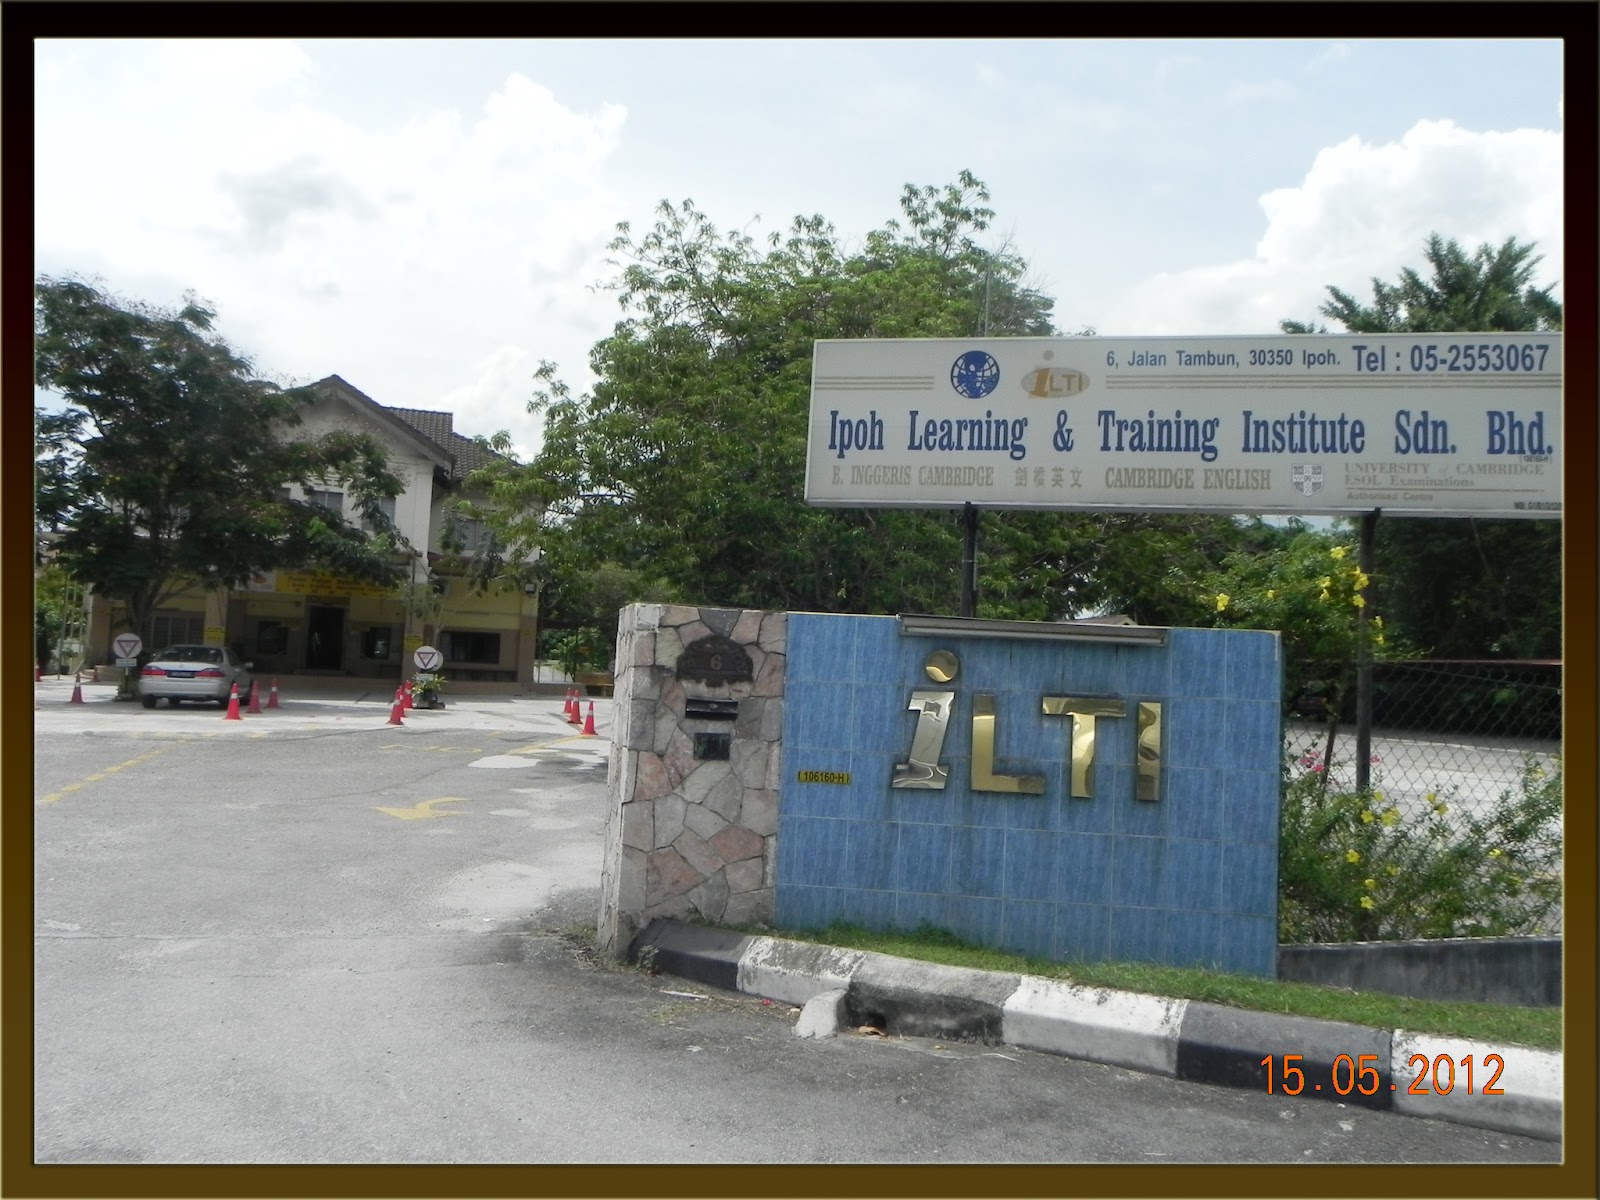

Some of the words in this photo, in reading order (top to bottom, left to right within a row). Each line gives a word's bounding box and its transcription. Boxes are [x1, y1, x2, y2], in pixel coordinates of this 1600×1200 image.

[1106, 350, 1119, 369] 6,
[1127, 350, 1167, 367] Jalan
[1176, 350, 1240, 369] Tambun,
[1249, 349, 1293, 366] 30350
[1302, 349, 1341, 369] Ipoh.
[1352, 345, 1386, 372] Tel
[1410, 344, 1550, 372] 05-2553067
[828, 410, 884, 459] Ipoh
[907, 409, 1028, 461] Learning
[1053, 409, 1074, 452] &
[1098, 409, 1220, 463] Training
[1242, 409, 1365, 454] Institute
[1395, 409, 1457, 455] Sdn.
[1486, 410, 1554, 455] Bhd.
[850, 465, 912, 487] INGGERIS
[918, 466, 994, 487] CAMBRIDGE
[1105, 467, 1195, 489] CAMBRIDGE
[1203, 468, 1271, 490] ENGLISH
[1344, 463, 1430, 474] UNIVERSITY
[1456, 463, 1544, 475] CAMBRIDGE
[1344, 475, 1381, 486] ESOL
[1390, 475, 1475, 487] Examinations
[1402, 492, 1434, 501] Centre
[710, 654, 721, 670] 6
